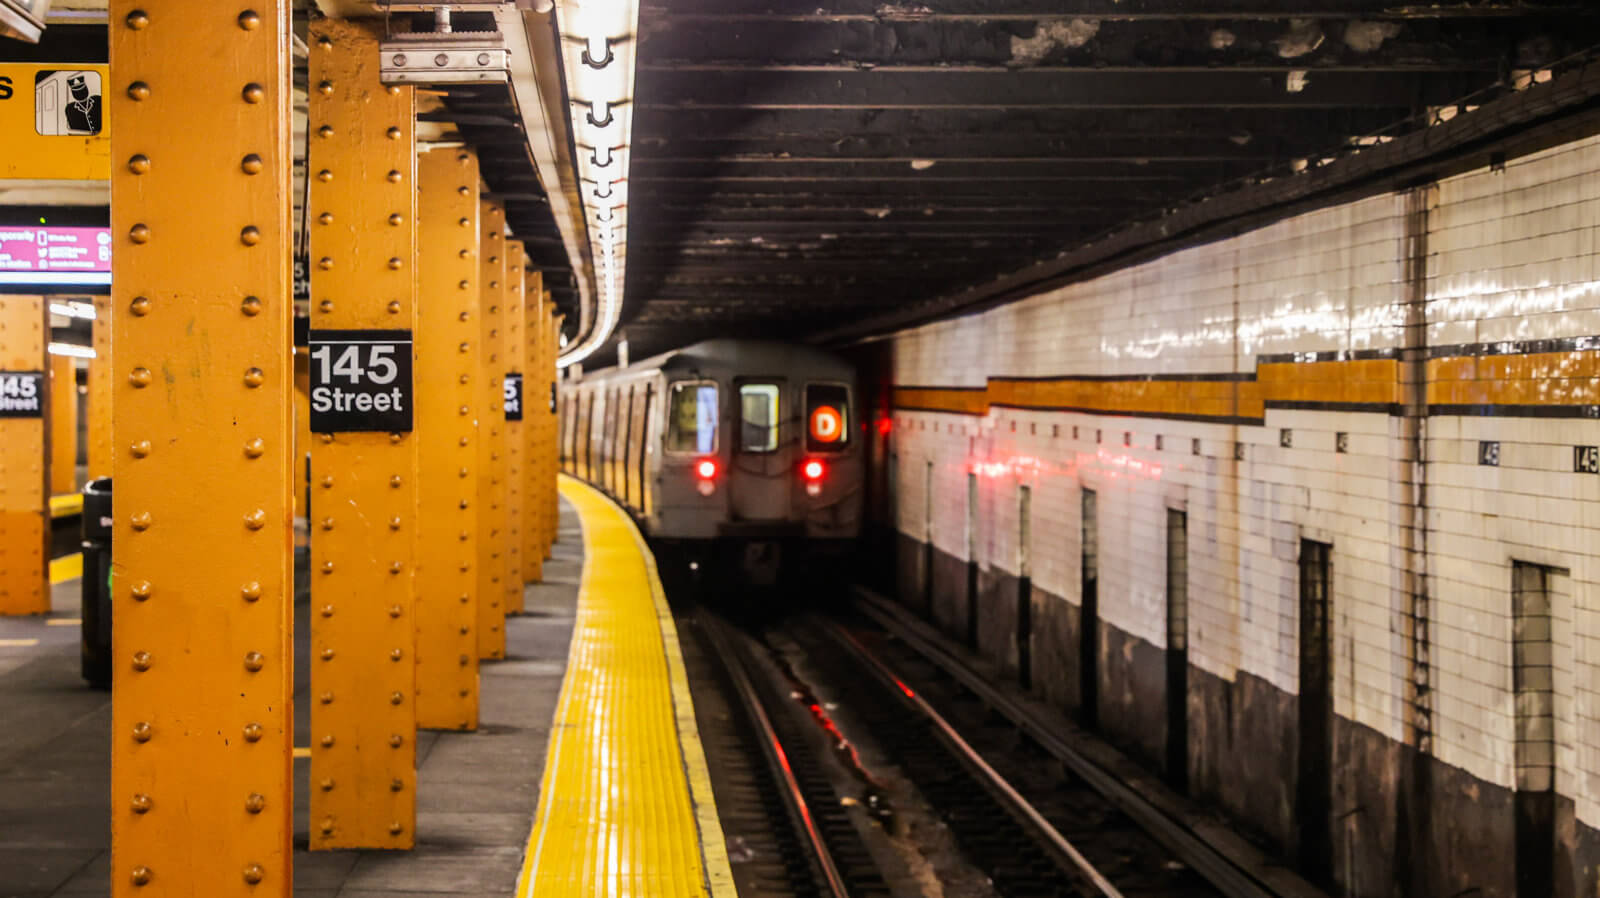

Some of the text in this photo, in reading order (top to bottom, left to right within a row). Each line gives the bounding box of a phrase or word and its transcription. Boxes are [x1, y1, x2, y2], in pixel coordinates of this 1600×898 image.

[311, 345, 398, 384] 145
[311, 387, 402, 412] Street
[816, 413, 836, 436] D
[1575, 447, 1598, 472] 145
